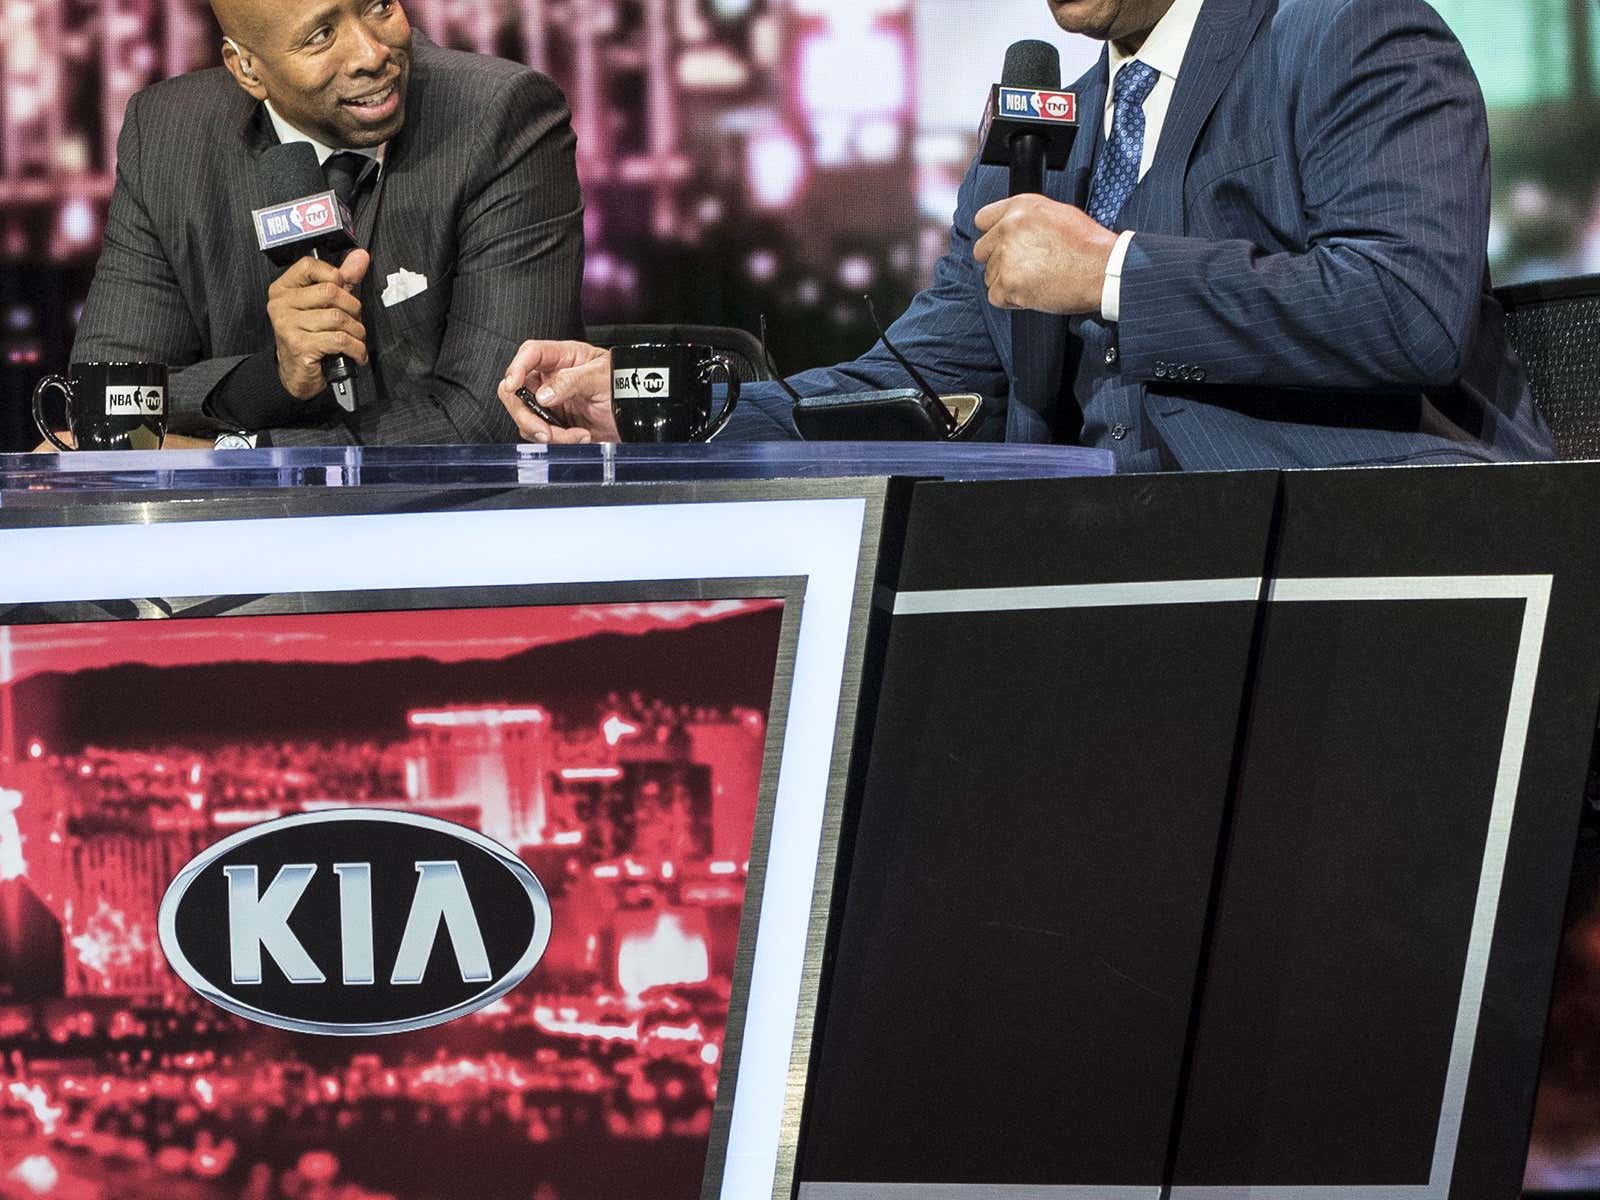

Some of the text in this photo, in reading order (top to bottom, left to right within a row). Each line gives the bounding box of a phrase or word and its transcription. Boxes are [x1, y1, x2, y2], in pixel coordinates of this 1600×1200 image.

[1006, 93, 1069, 112] NBA TNT
[267, 209, 328, 237] NBA TNT
[615, 376, 665, 390] NBA TNT
[110, 394, 132, 406] NBA
[222, 859, 493, 986] KIA
